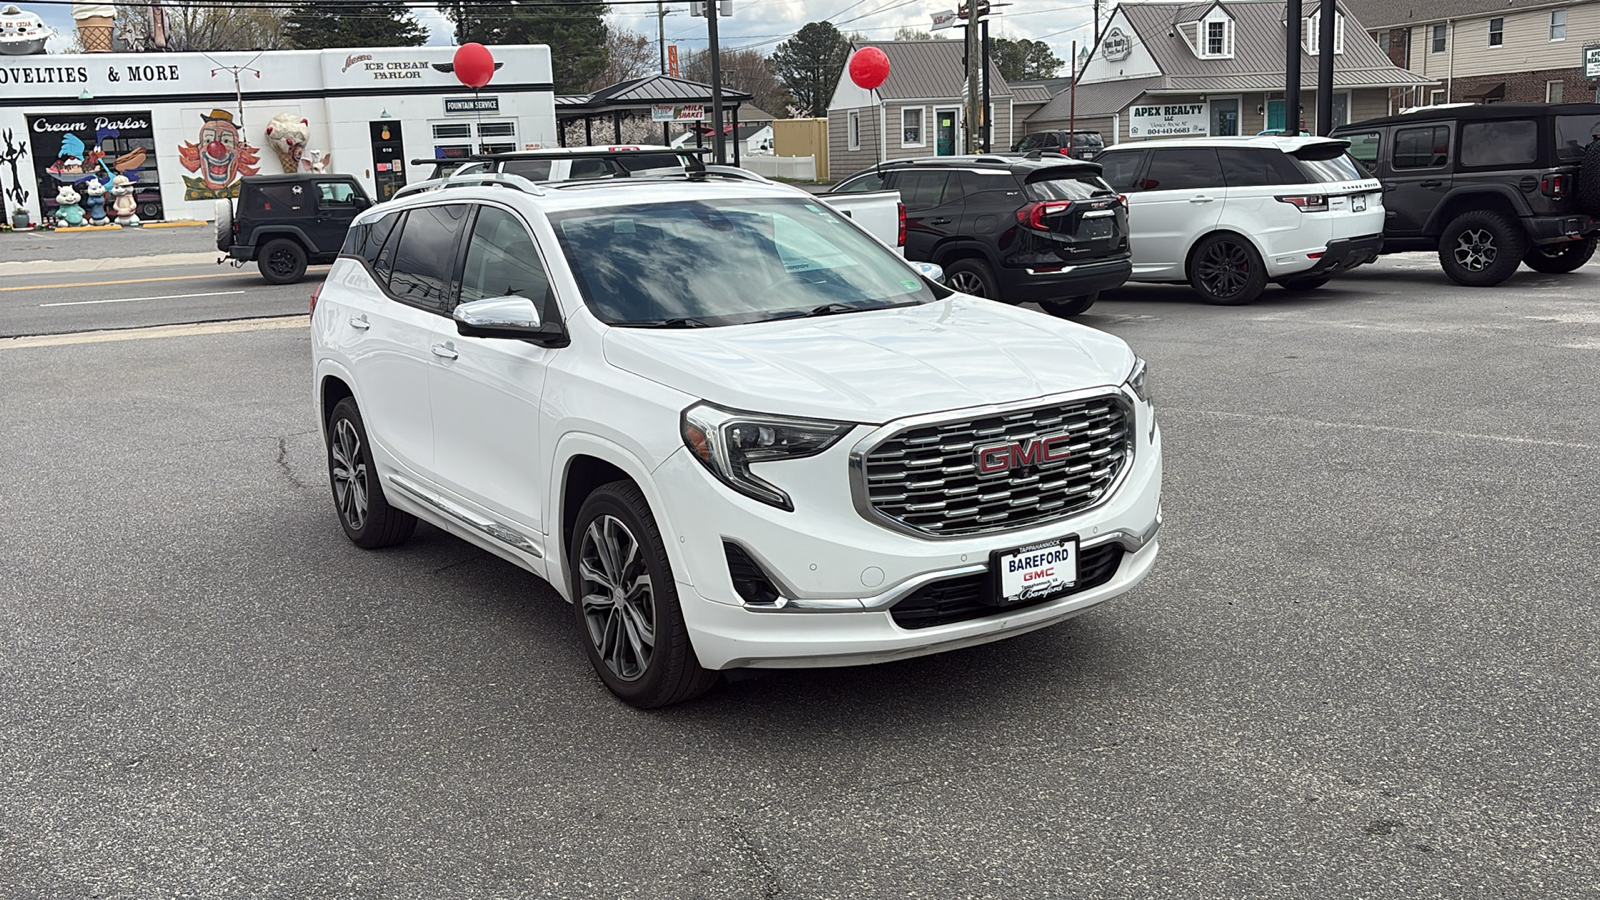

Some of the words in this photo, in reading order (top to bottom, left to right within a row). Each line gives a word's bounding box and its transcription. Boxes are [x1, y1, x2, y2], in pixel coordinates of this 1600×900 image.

[386, 61, 429, 70] CREAM
[108, 66, 120, 82] &
[128, 65, 179, 81] MORE
[373, 71, 421, 79] PARLOR
[447, 101, 475, 110] FOUNTAIN
[475, 100, 497, 109] SERVICE
[1134, 107, 1161, 117] APEX
[1164, 105, 1203, 115] REALTY
[33, 118, 87, 133] Cream
[94, 117, 149, 130] Parlor
[977, 433, 1070, 474] GMC
[1020, 540, 1061, 553] TAPPAHANNOCK
[1009, 549, 1069, 573] BAREFORD
[1024, 567, 1055, 582] GMC
